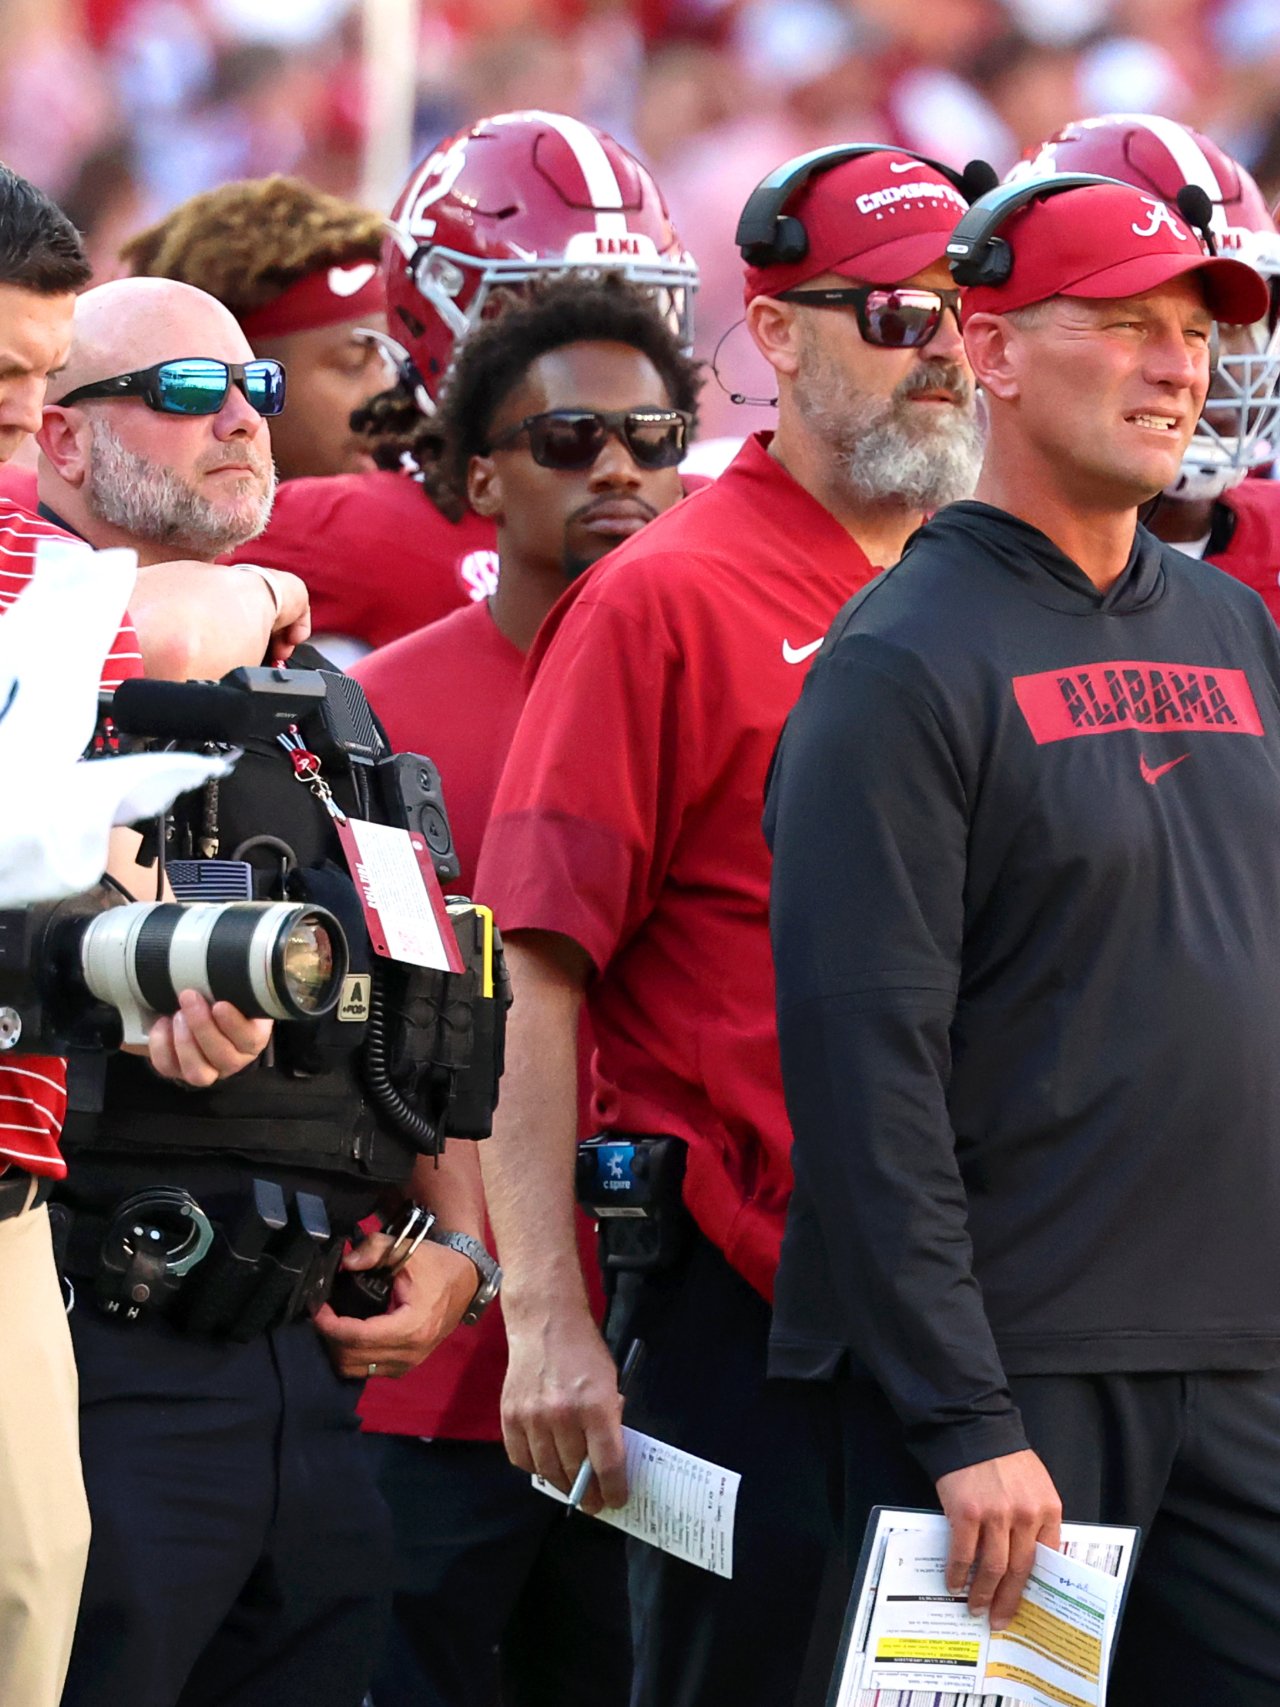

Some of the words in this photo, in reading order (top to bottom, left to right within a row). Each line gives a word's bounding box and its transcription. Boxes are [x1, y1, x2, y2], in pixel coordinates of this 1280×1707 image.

[1131, 196, 1187, 241] A
[1056, 669, 1239, 728] ALABAMA
[350, 981, 363, 1002] A
